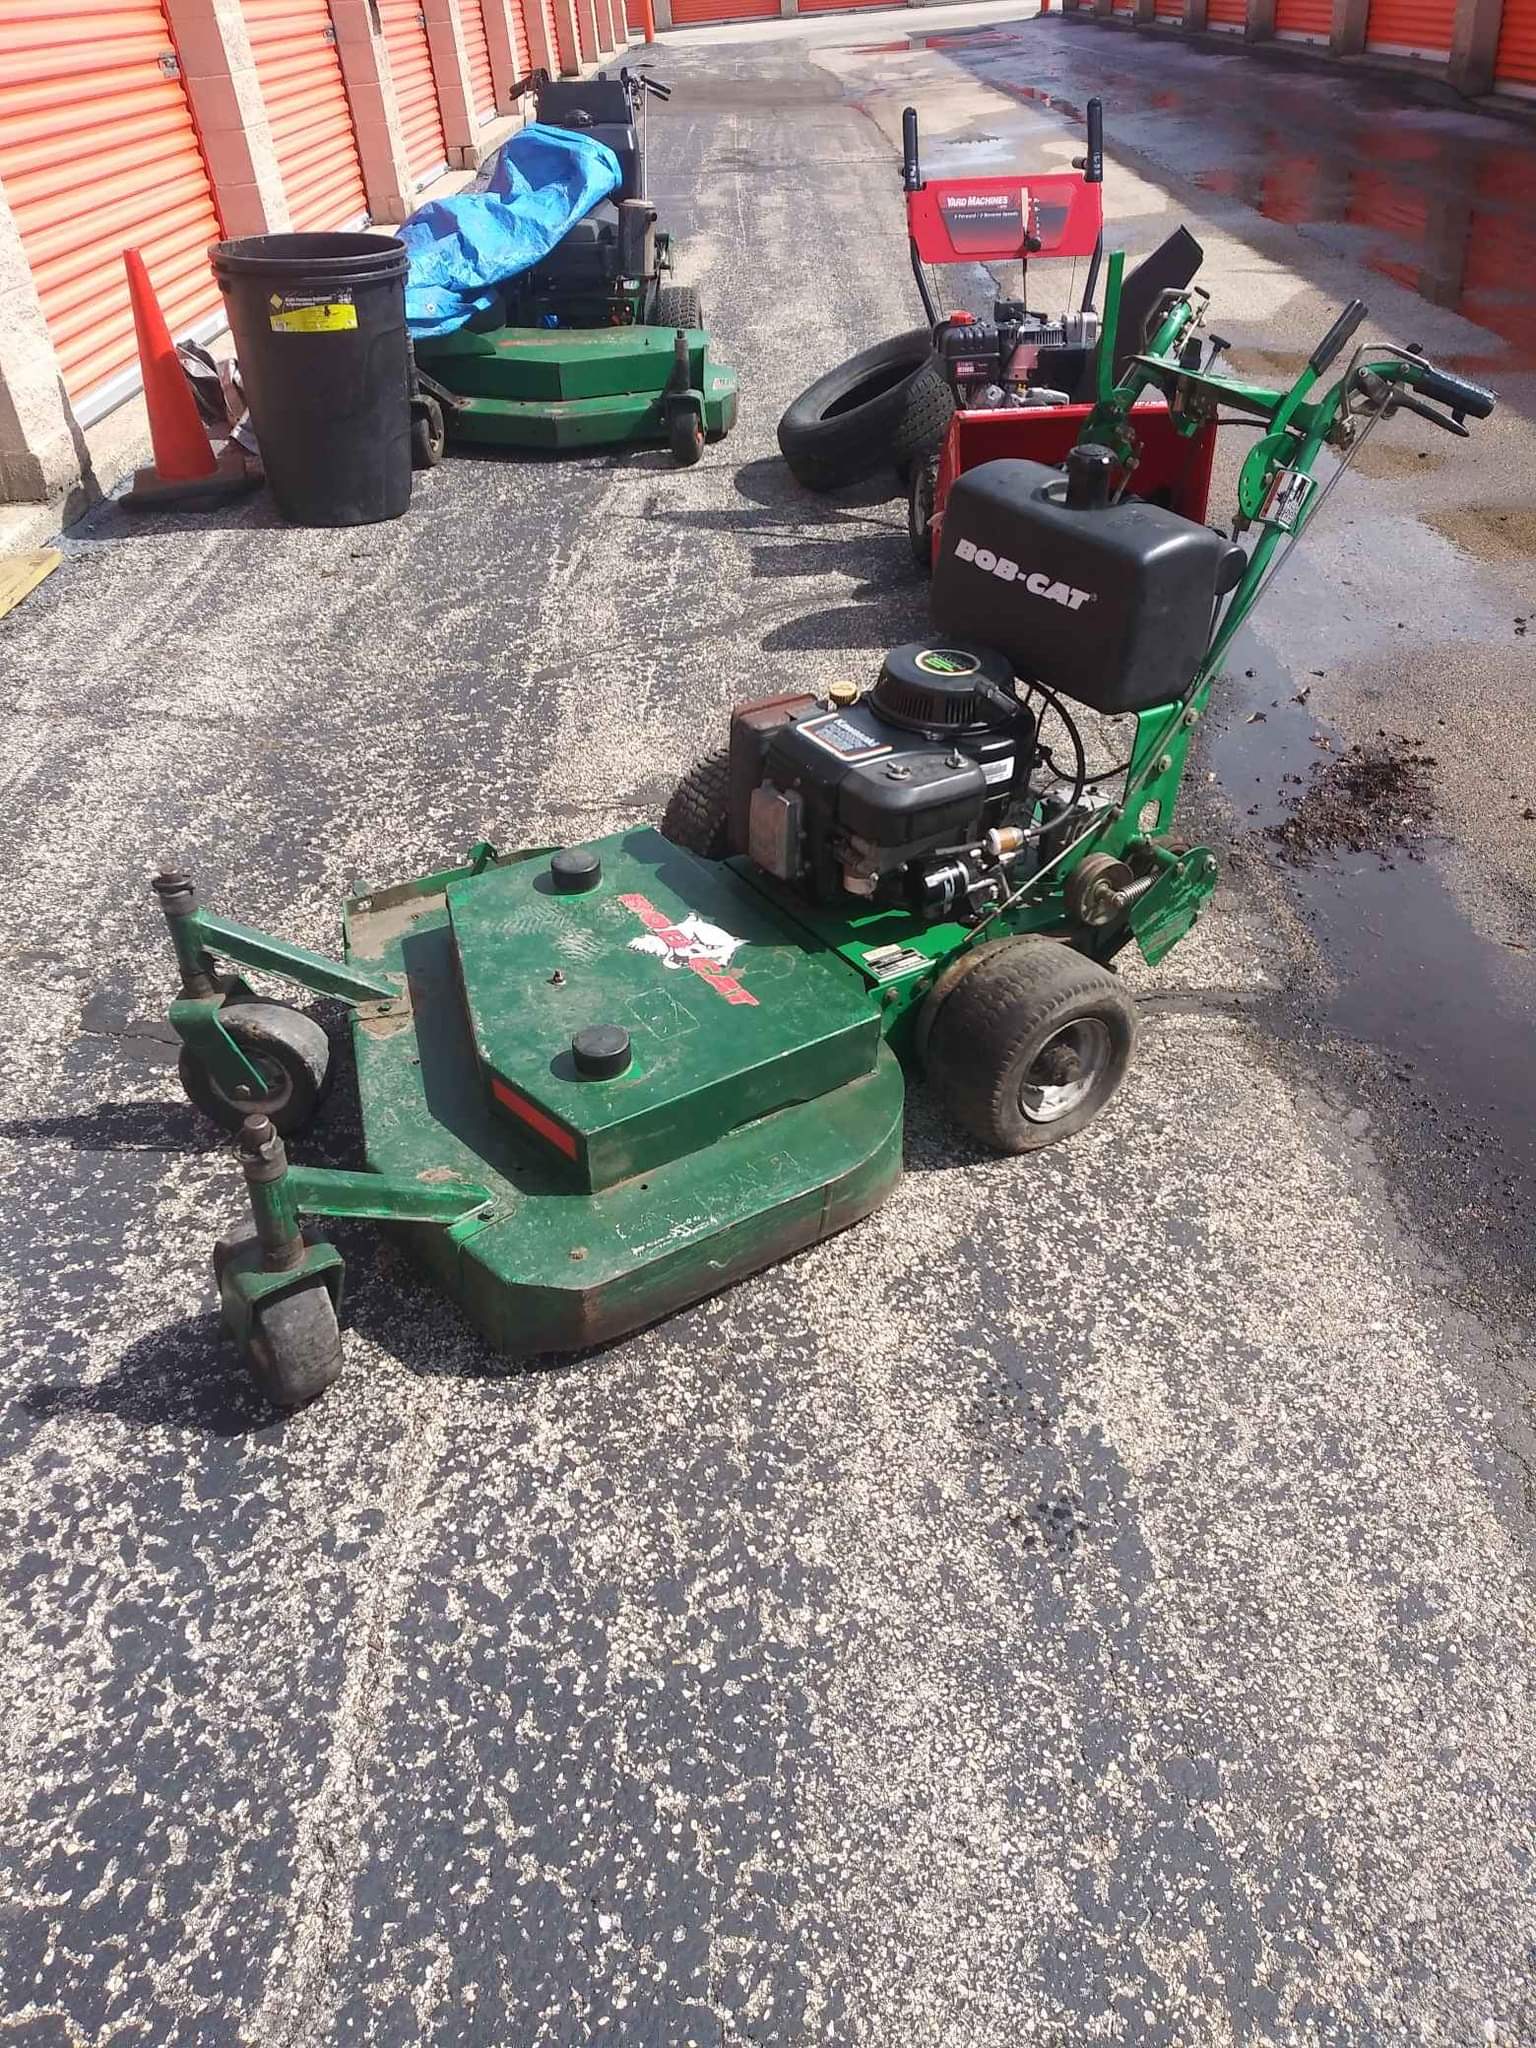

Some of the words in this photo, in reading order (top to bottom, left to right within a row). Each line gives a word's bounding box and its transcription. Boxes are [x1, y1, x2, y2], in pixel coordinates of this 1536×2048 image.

[947, 197, 967, 208] YARD
[967, 196, 1008, 206] MACHINES
[954, 538, 1091, 611] BOB-CAT
